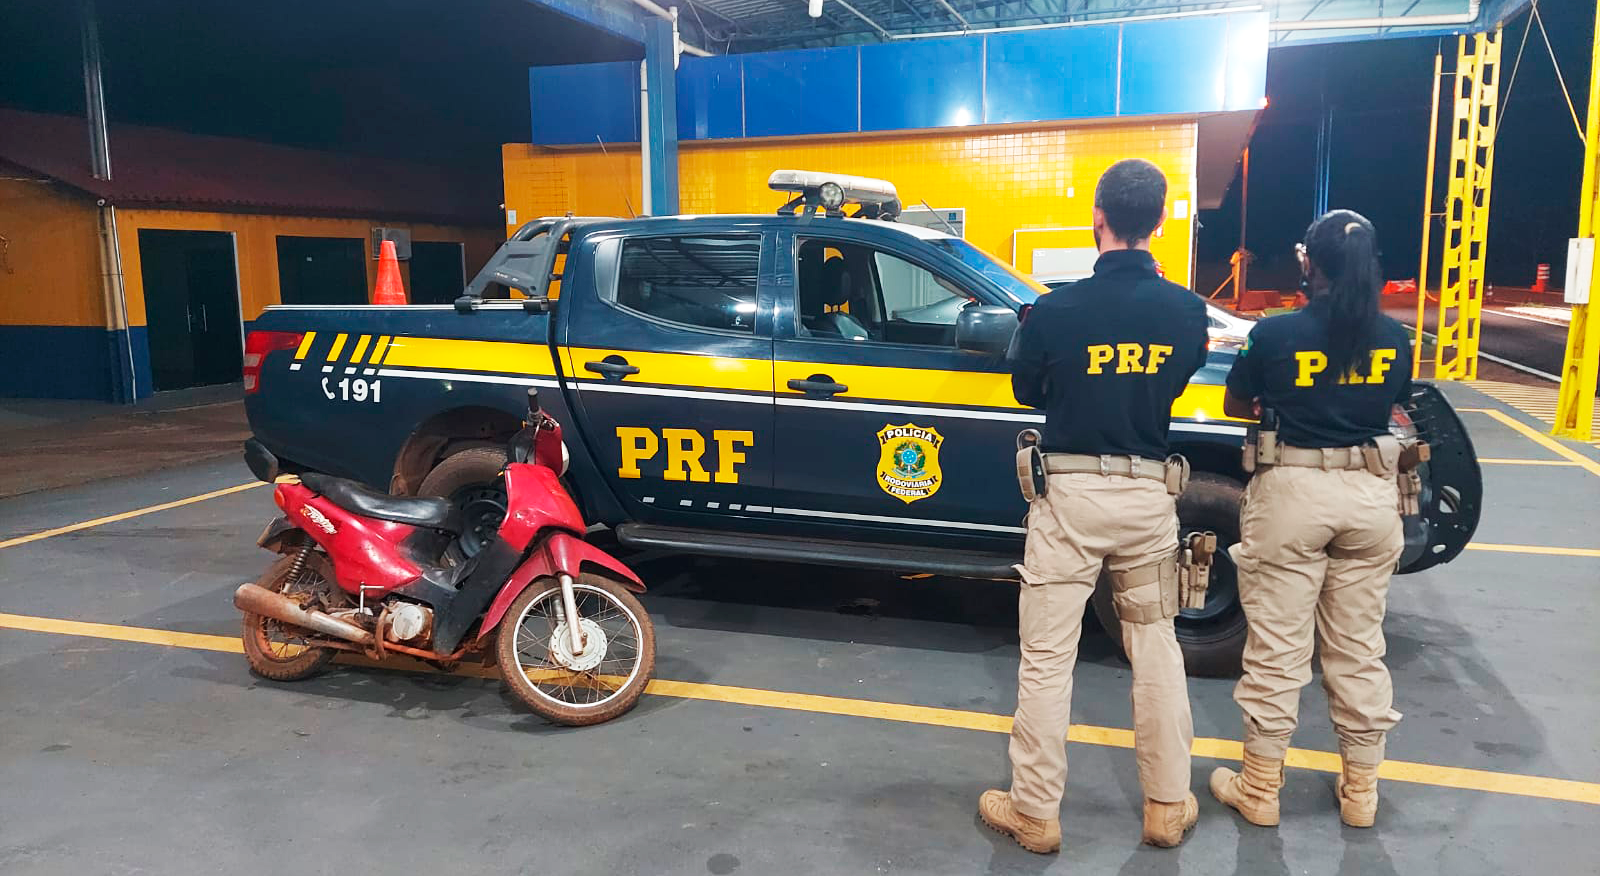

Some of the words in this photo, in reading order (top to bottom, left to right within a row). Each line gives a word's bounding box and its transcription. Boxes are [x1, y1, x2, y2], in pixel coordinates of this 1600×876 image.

[1087, 343, 1173, 374] PRF
[338, 378, 381, 403] 191
[616, 427, 754, 484] PRF
[891, 487, 927, 496] FEDERAL
